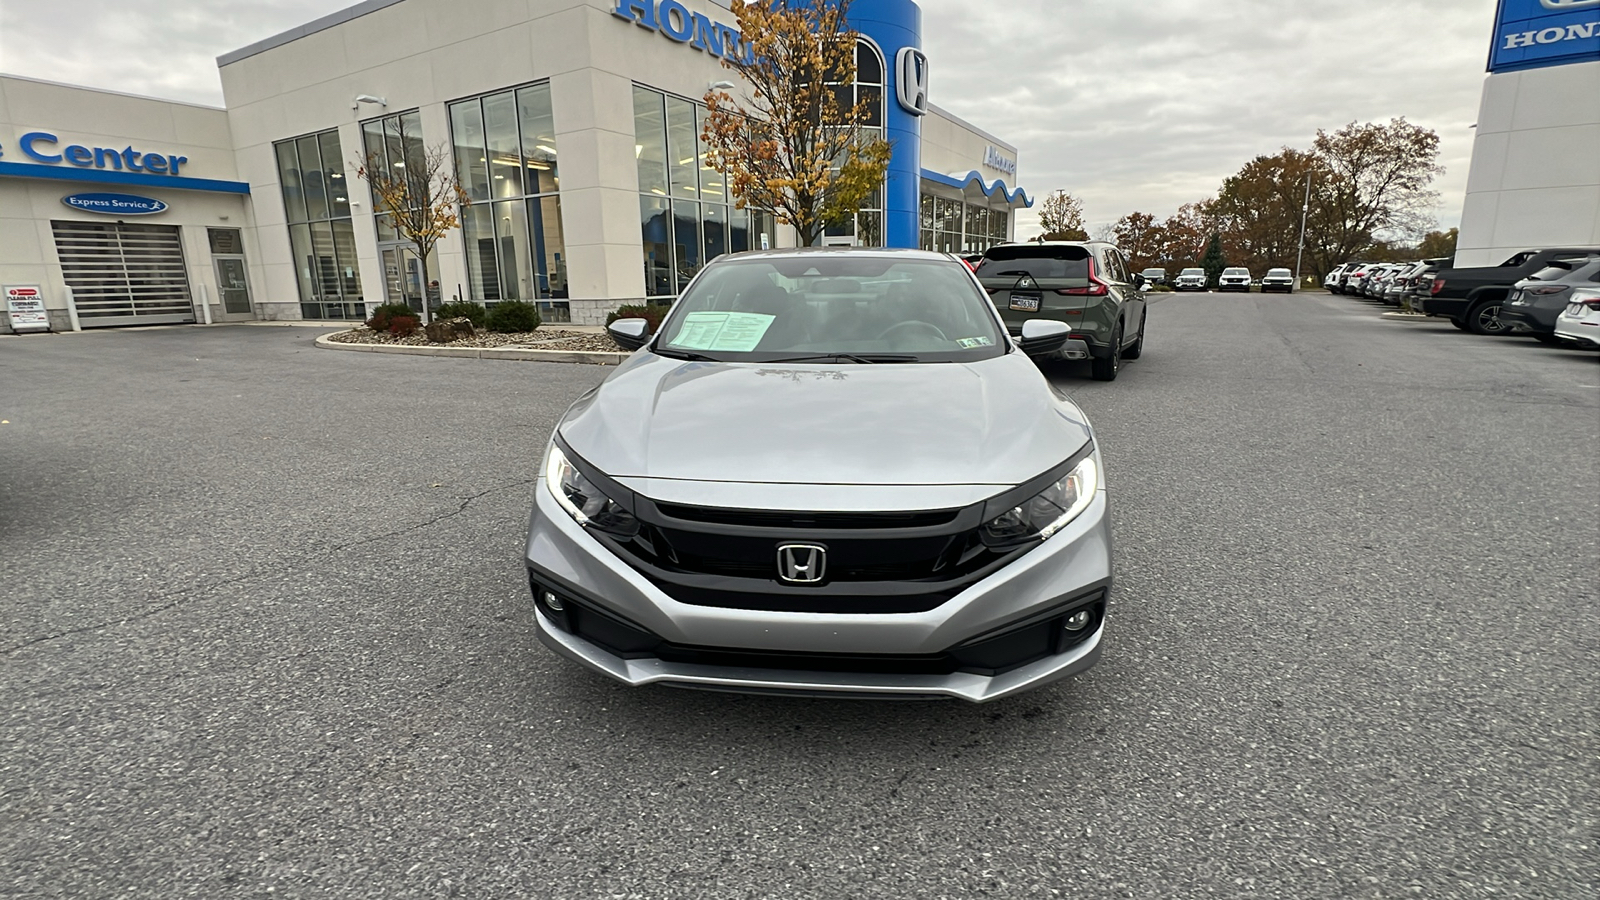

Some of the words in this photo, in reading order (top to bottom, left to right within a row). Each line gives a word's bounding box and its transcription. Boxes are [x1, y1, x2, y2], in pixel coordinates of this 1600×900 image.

[611, 0, 783, 79] HOND
[1502, 21, 1600, 50] HON
[19, 131, 188, 176] Center
[69, 197, 110, 207] Express
[111, 199, 149, 209] Service
